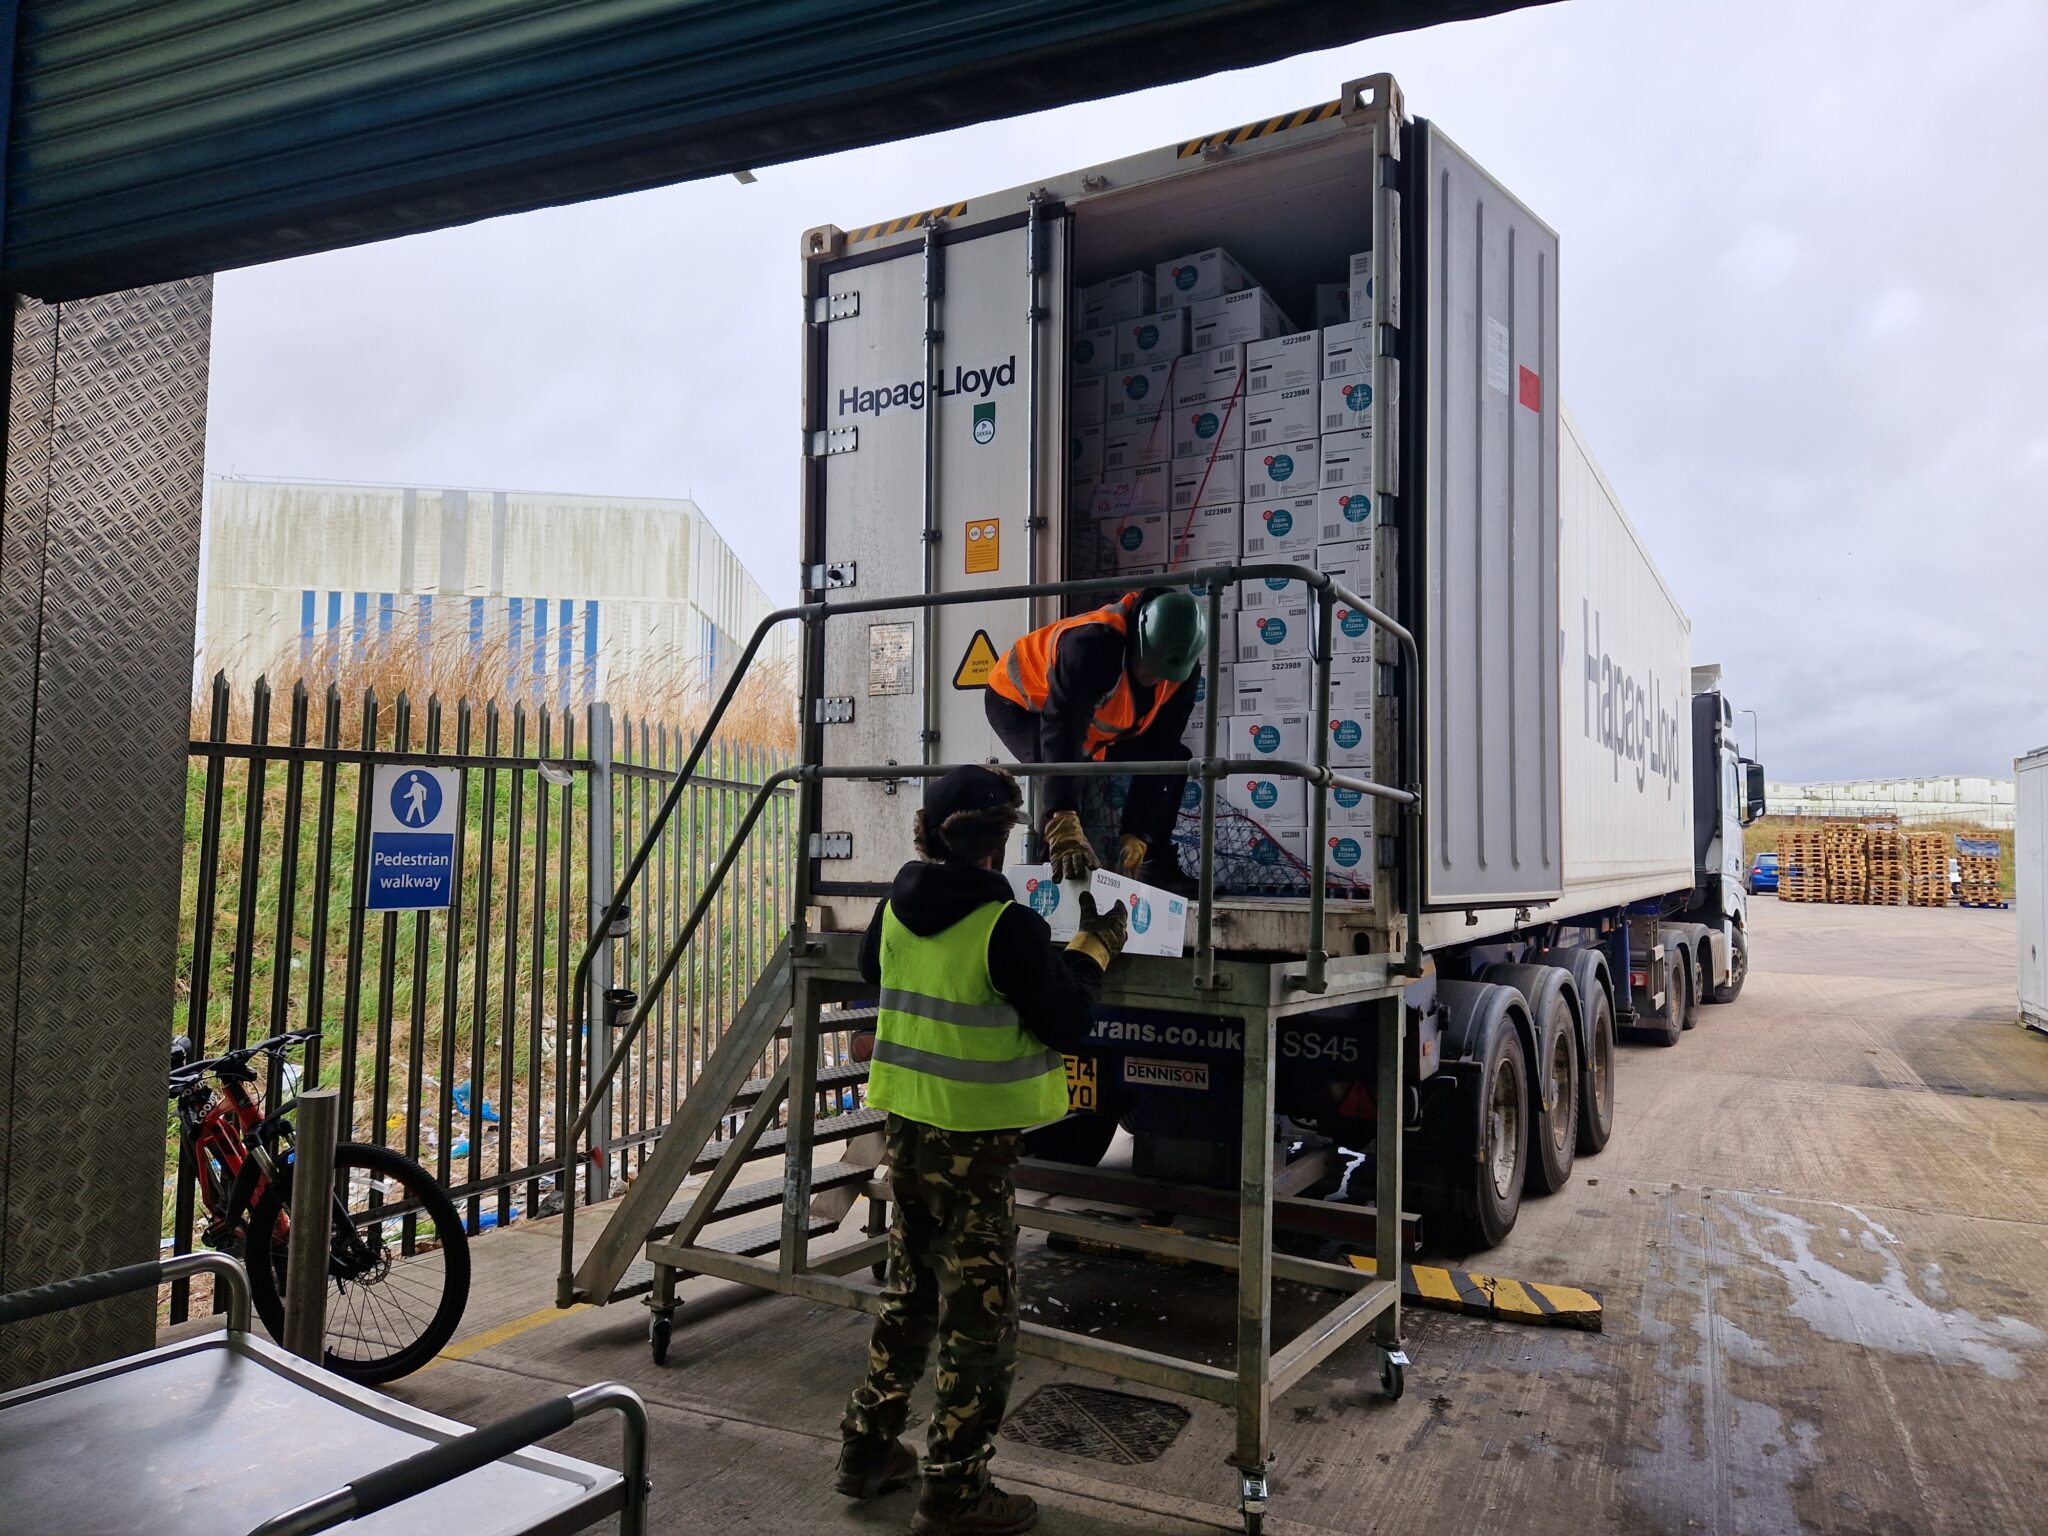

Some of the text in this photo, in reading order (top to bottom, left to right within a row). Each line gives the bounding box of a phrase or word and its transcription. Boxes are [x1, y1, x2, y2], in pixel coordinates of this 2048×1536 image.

[1225, 292, 1253, 304] 5223989
[1282, 335, 1310, 345] 5223989
[1281, 389, 1309, 399] 5223989
[1204, 507, 1232, 517] 5223989
[1271, 662, 1301, 670] 5223989
[1583, 597, 1680, 801] Hapag-Lloyd
[375, 852, 449, 866] Pedestrian
[380, 874, 441, 891] walkway
[1096, 874, 1121, 889] 5223989
[1281, 1029, 1359, 1063] SS45
[1063, 1058, 1095, 1082] E14
[1127, 1064, 1207, 1084] DENNISON
